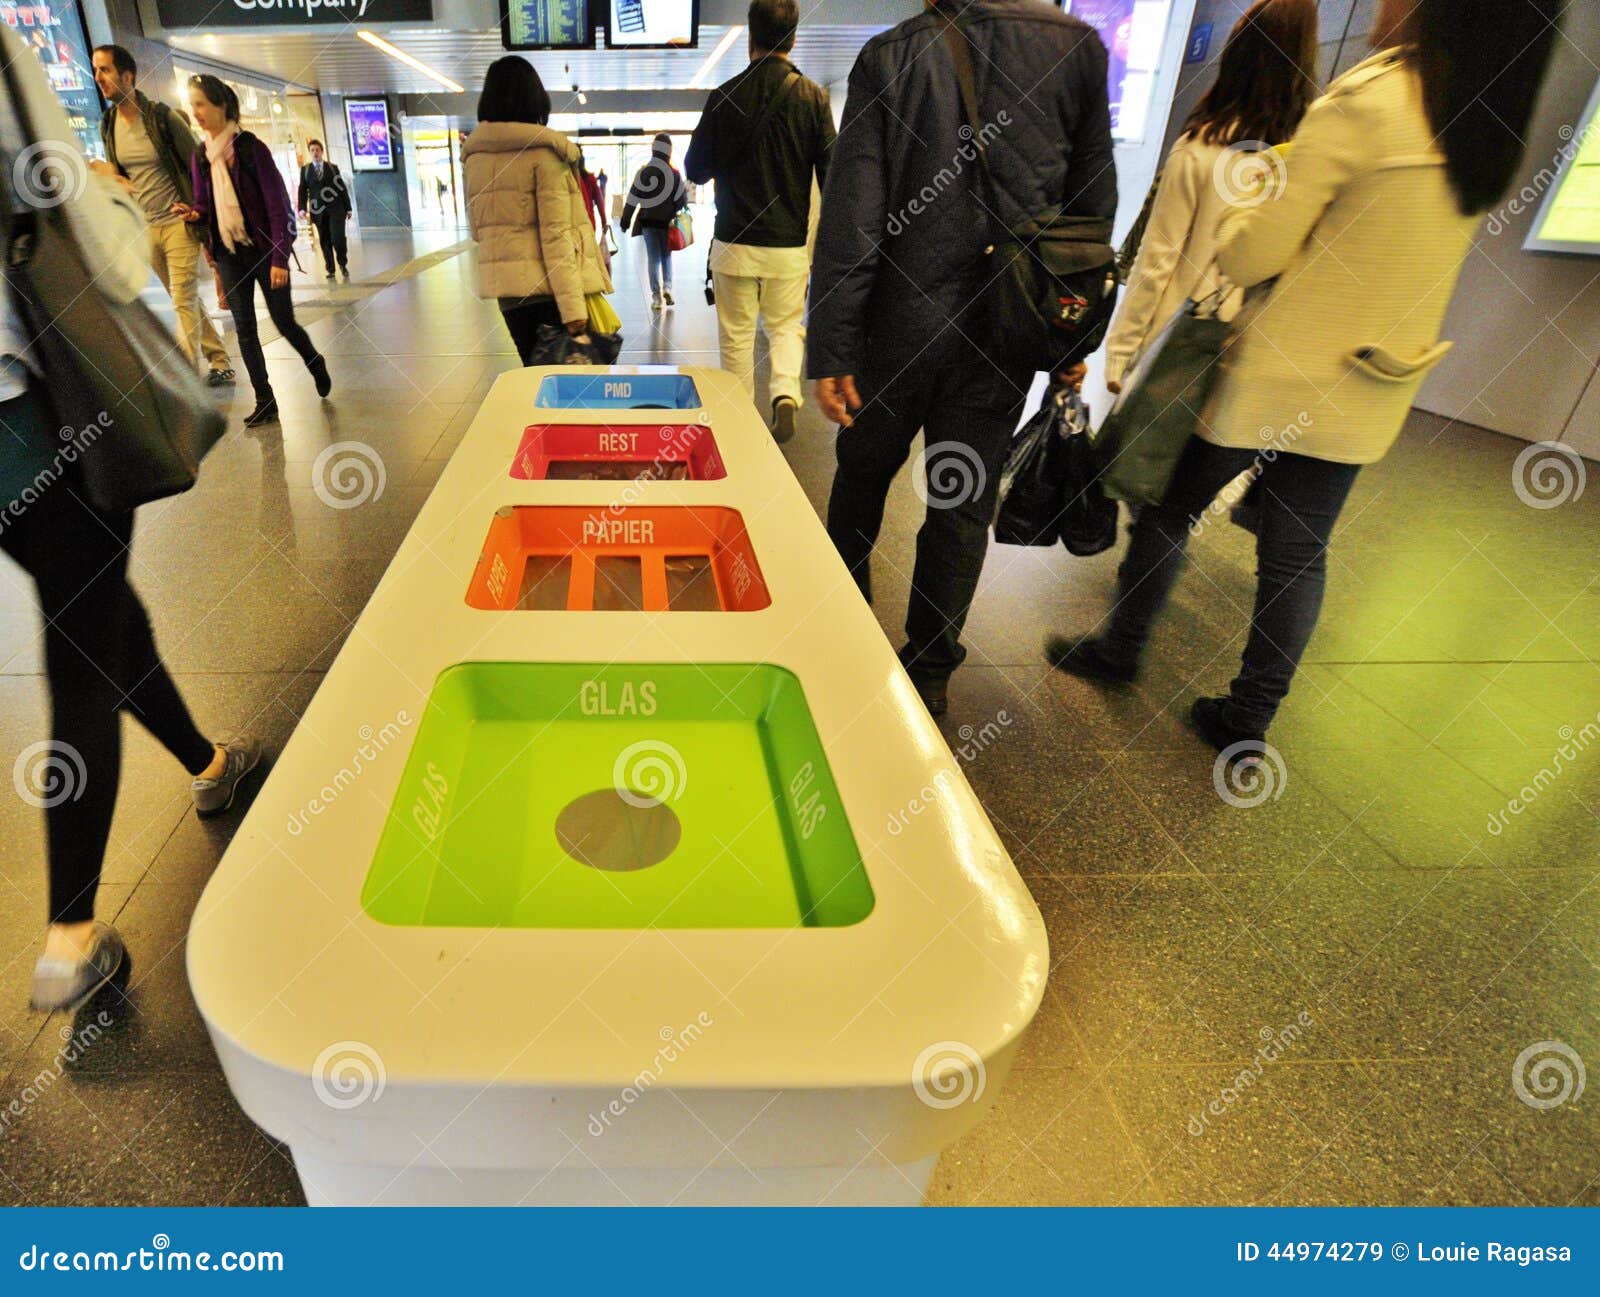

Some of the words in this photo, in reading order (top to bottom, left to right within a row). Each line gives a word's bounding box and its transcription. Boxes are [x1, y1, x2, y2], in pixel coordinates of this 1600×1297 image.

[604, 382, 632, 399] PMD
[600, 433, 639, 452] REST
[582, 520, 655, 544] PAPIER
[580, 681, 657, 716] GLAS
[412, 761, 448, 840] GLAS
[790, 761, 827, 840] GLAS
